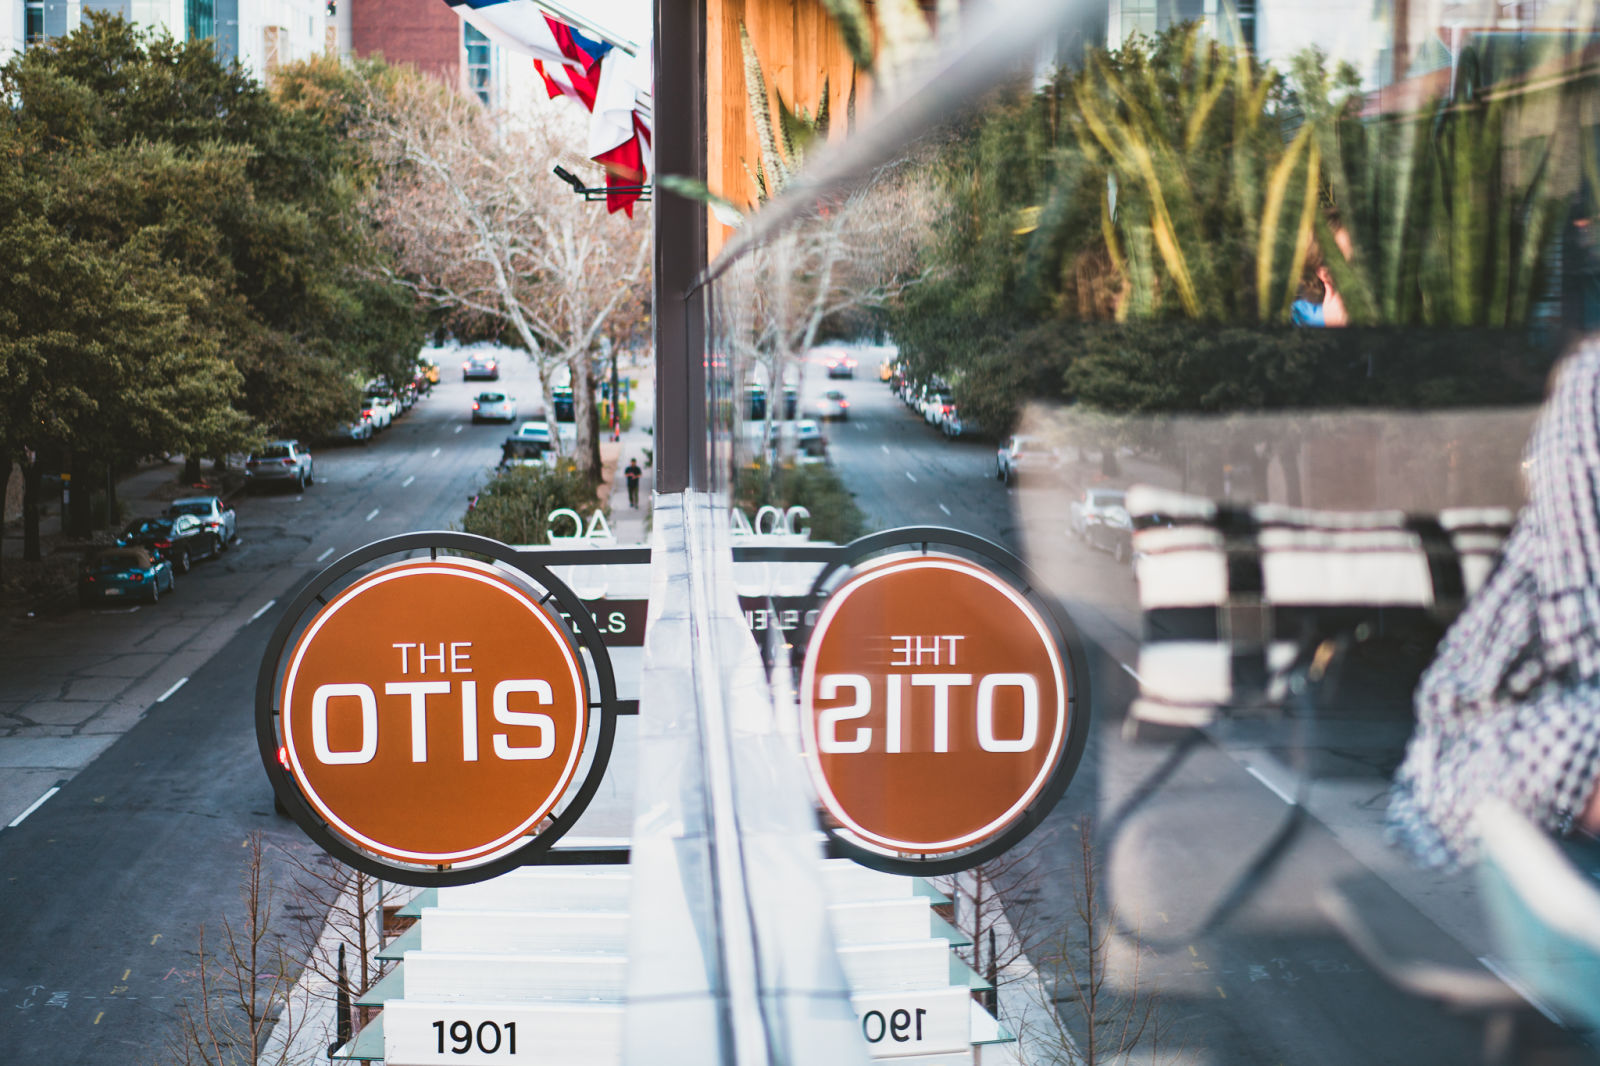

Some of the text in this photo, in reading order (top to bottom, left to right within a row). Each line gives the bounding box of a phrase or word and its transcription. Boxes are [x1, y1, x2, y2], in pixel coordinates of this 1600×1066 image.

[392, 642, 473, 674] THE
[311, 679, 556, 765] OTIS
[432, 1020, 517, 1055] 1901
